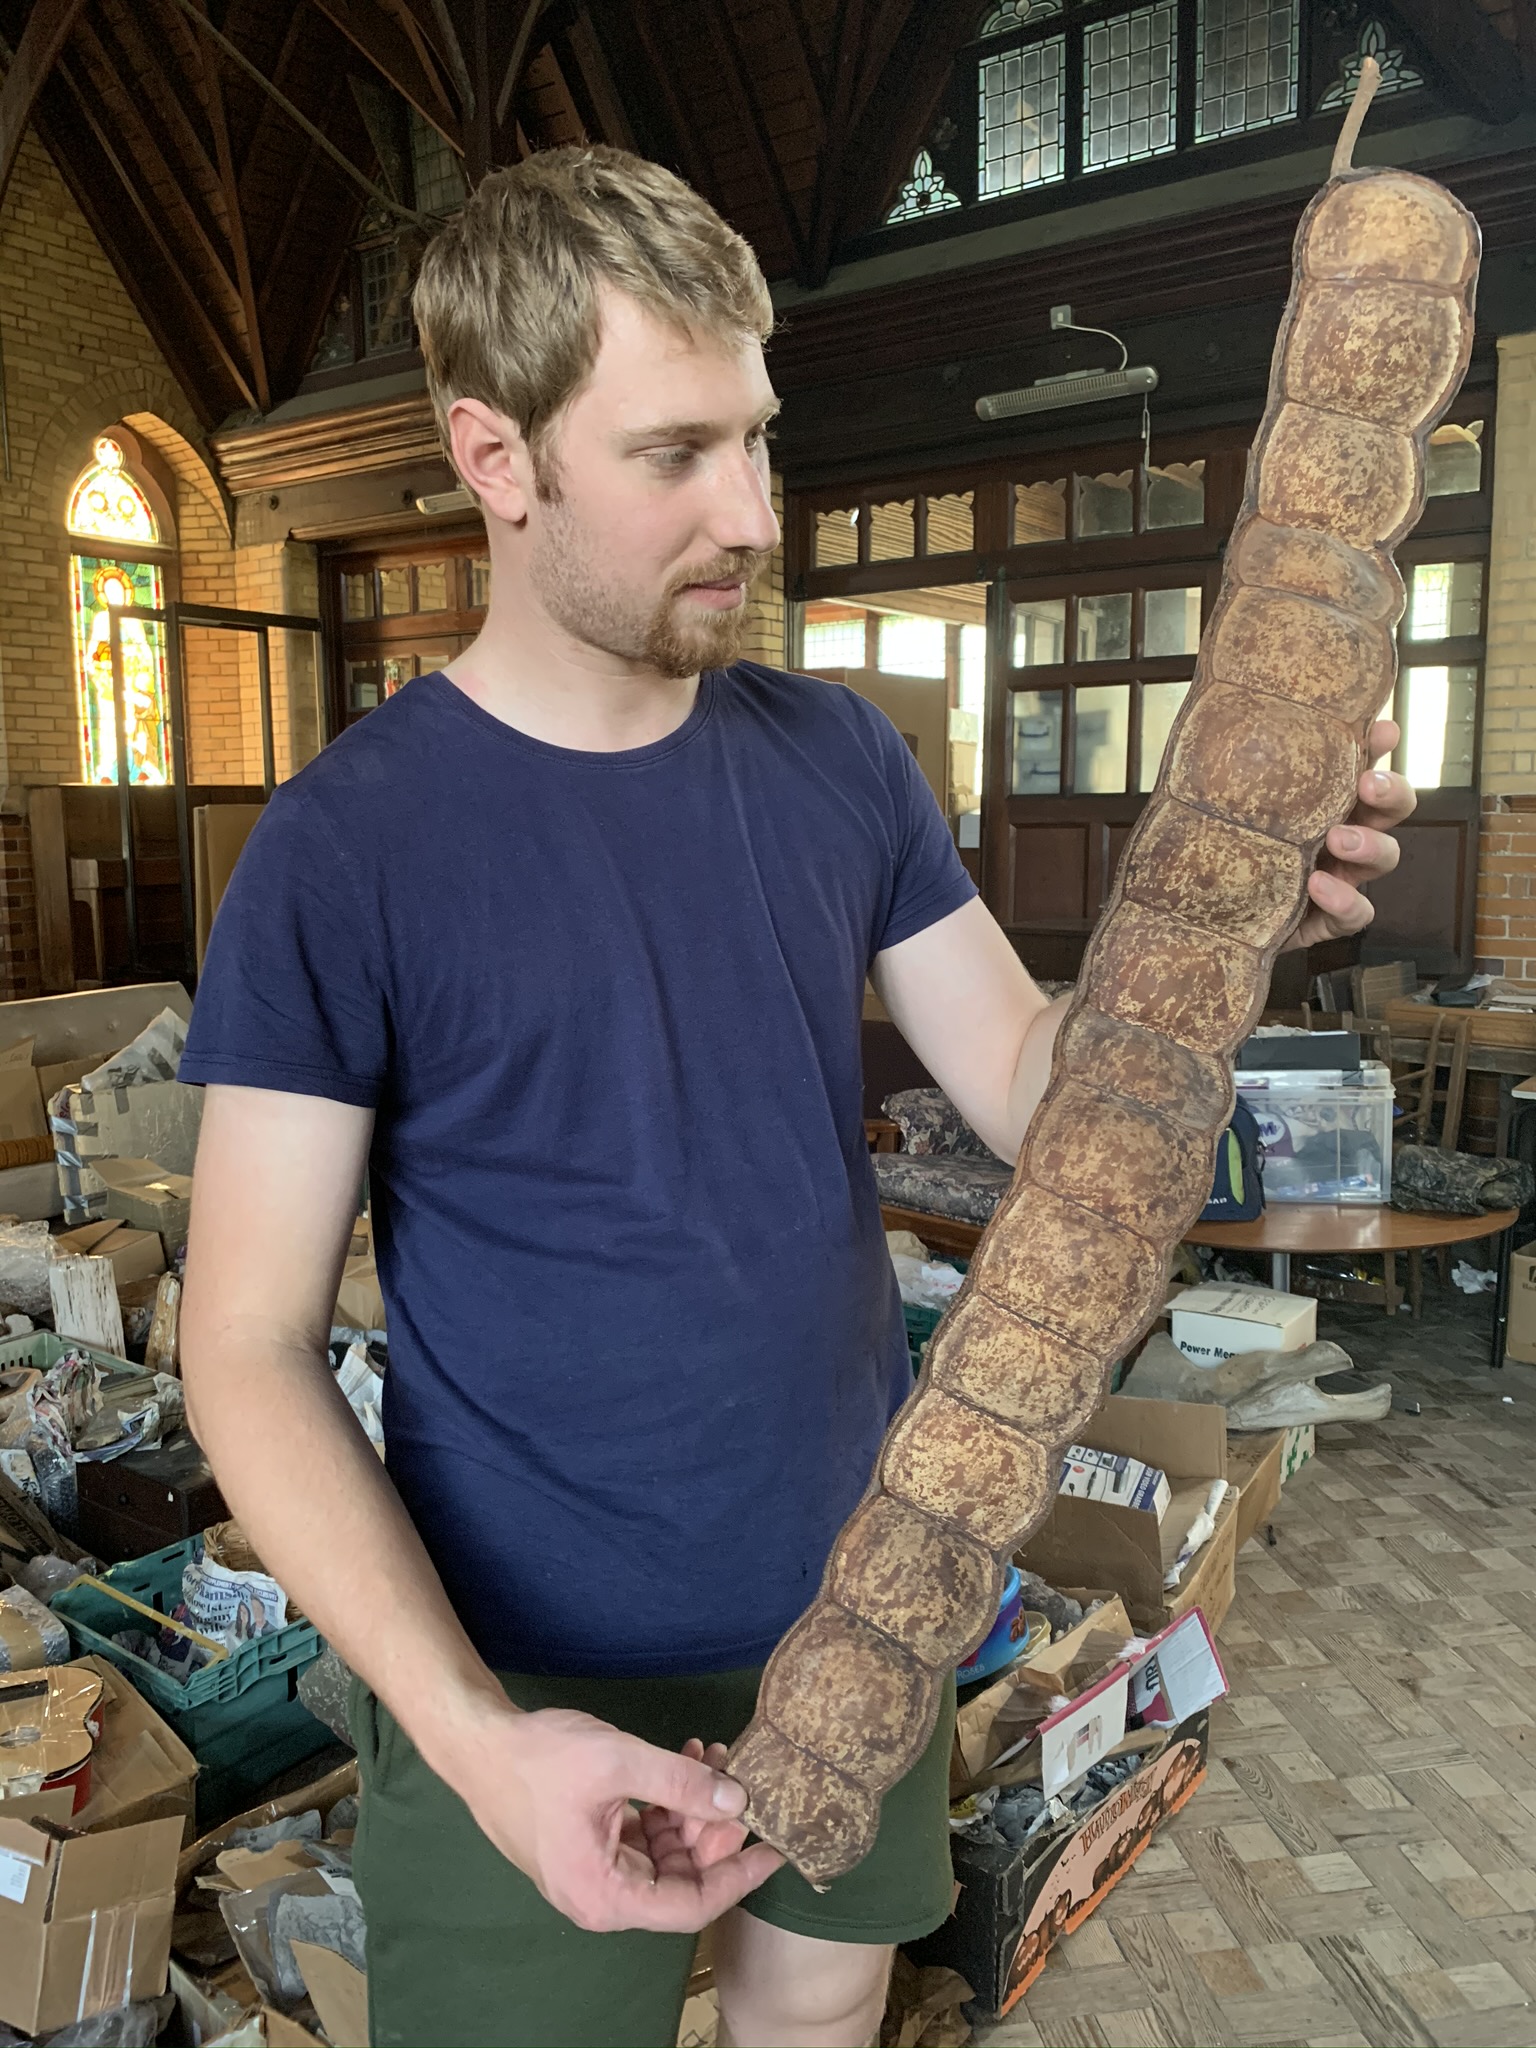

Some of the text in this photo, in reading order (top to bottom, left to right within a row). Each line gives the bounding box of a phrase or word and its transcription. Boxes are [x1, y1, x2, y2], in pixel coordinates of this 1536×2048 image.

[1180, 1340, 1211, 1356] Power
[1132, 1489, 1146, 1509] GRABBE
[957, 1664, 985, 1680] ROSES
